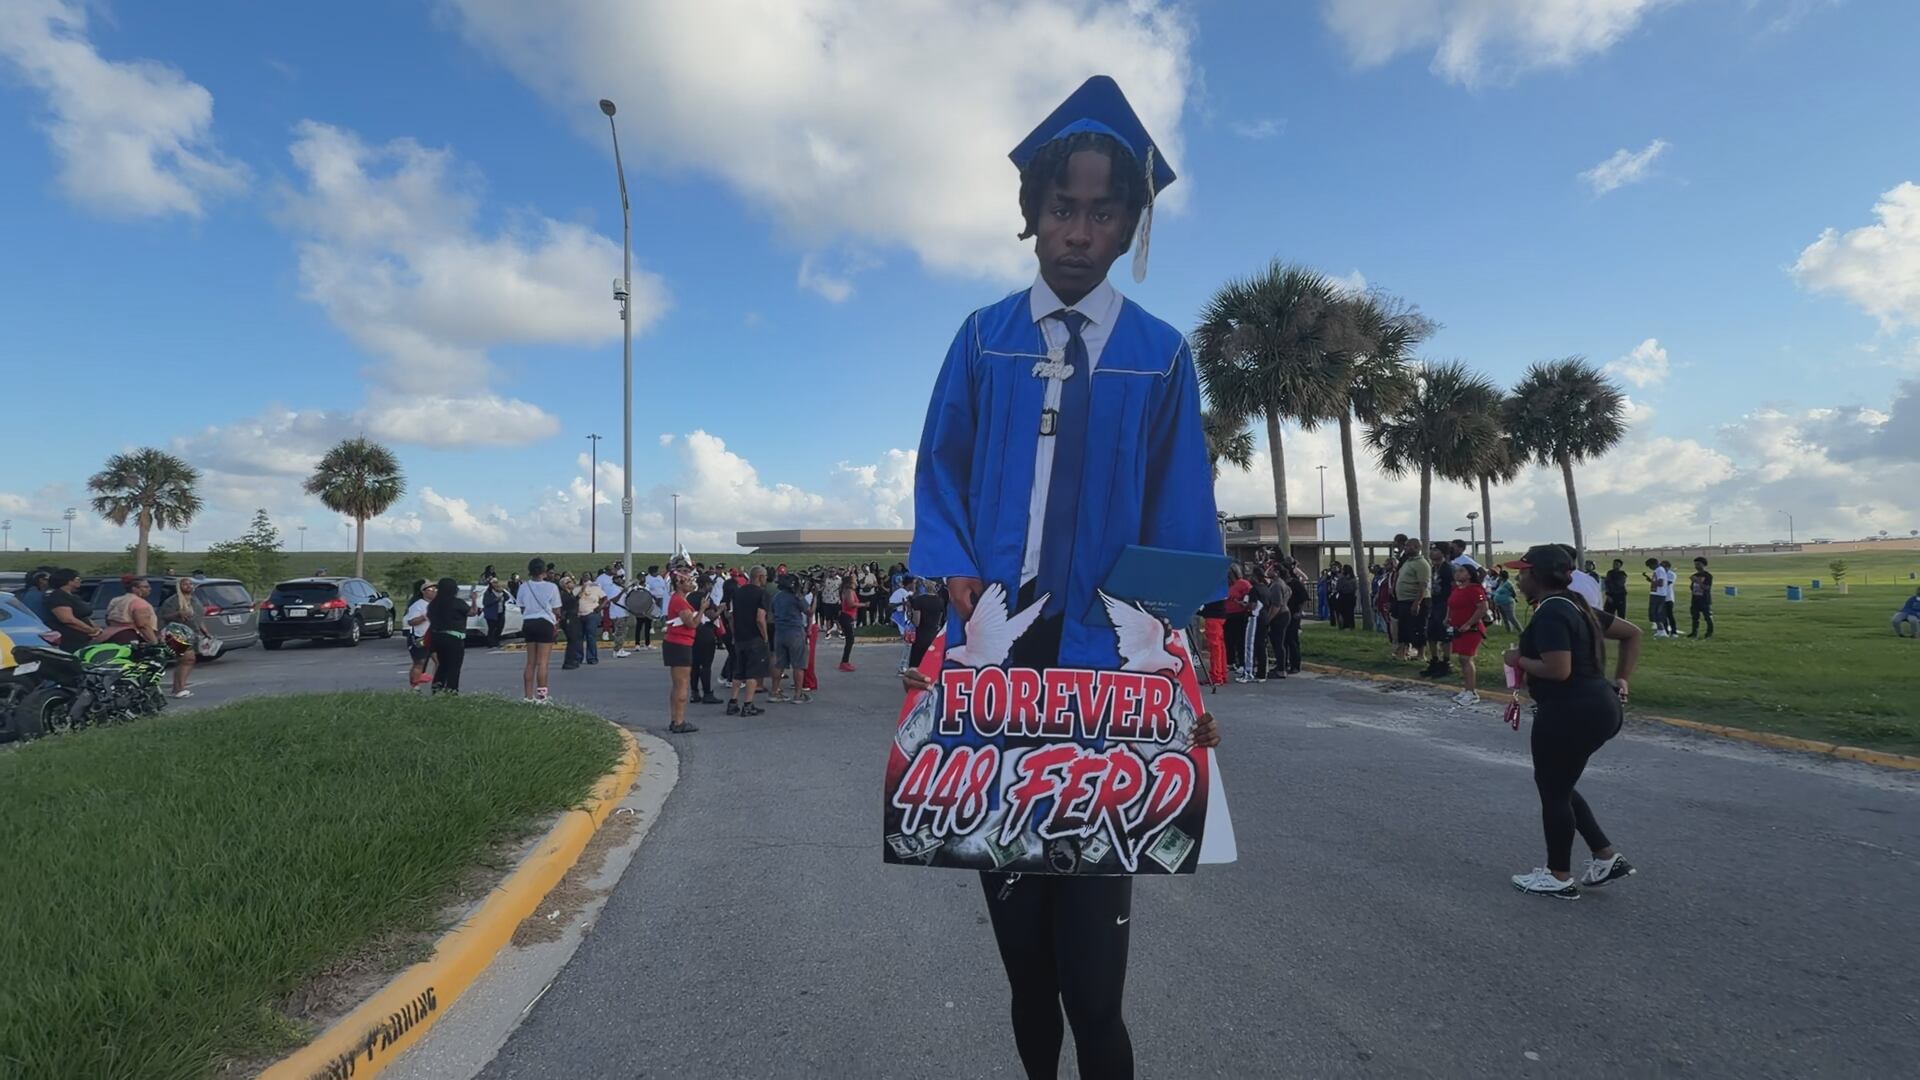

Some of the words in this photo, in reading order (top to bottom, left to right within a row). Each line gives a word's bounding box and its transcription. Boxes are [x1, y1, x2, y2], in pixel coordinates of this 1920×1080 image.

[940, 668, 1175, 742] FOREVER
[893, 744, 999, 836] 448
[999, 743, 1195, 872] FERD
[366, 987, 437, 1061] PARKING
